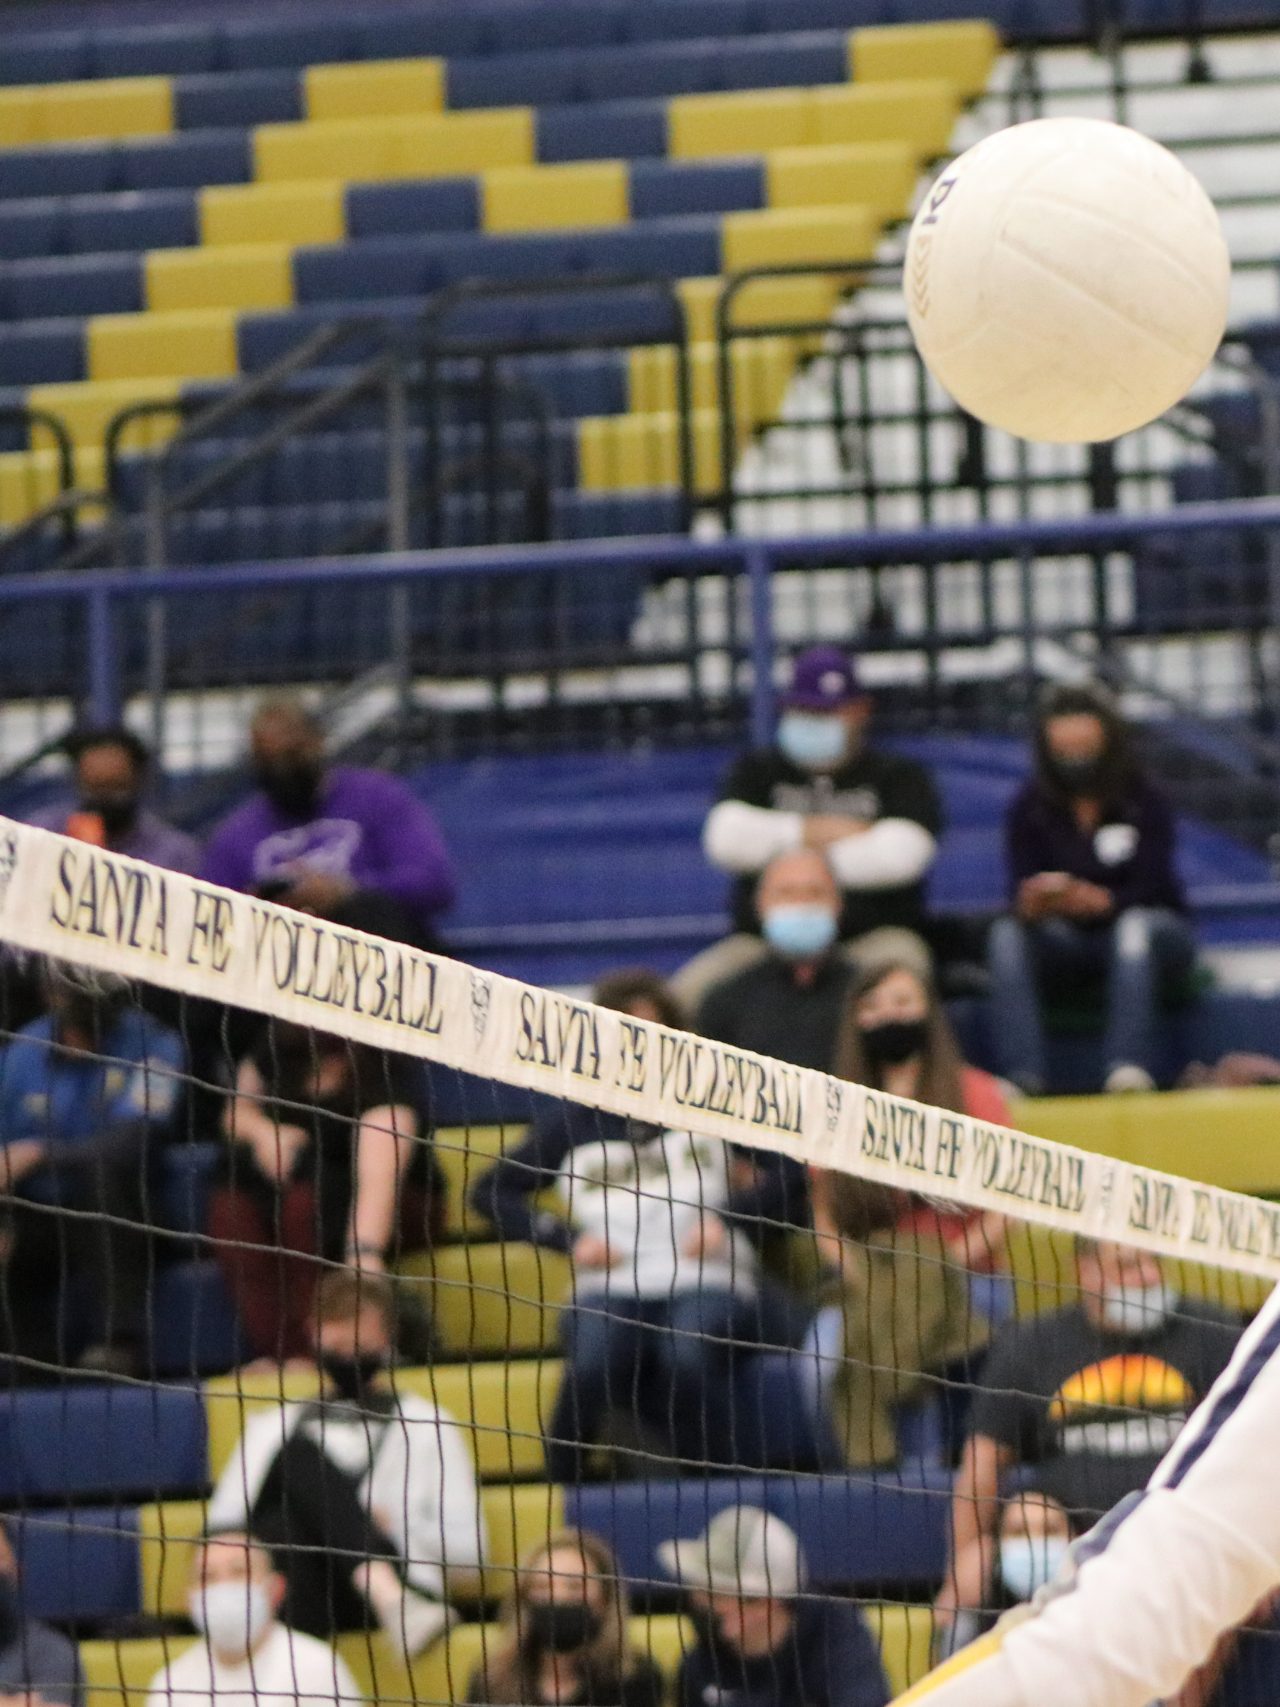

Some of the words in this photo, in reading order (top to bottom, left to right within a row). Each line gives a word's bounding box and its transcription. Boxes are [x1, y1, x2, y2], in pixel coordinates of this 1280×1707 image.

[51, 847, 168, 956] SANTA
[187, 888, 234, 973] FE
[250, 907, 443, 1034] VOLLEYBALL
[516, 991, 601, 1080] SANTA
[615, 1021, 648, 1092] FE
[659, 1033, 802, 1134] VOLLEYBALL
[862, 1095, 926, 1171] SANTA
